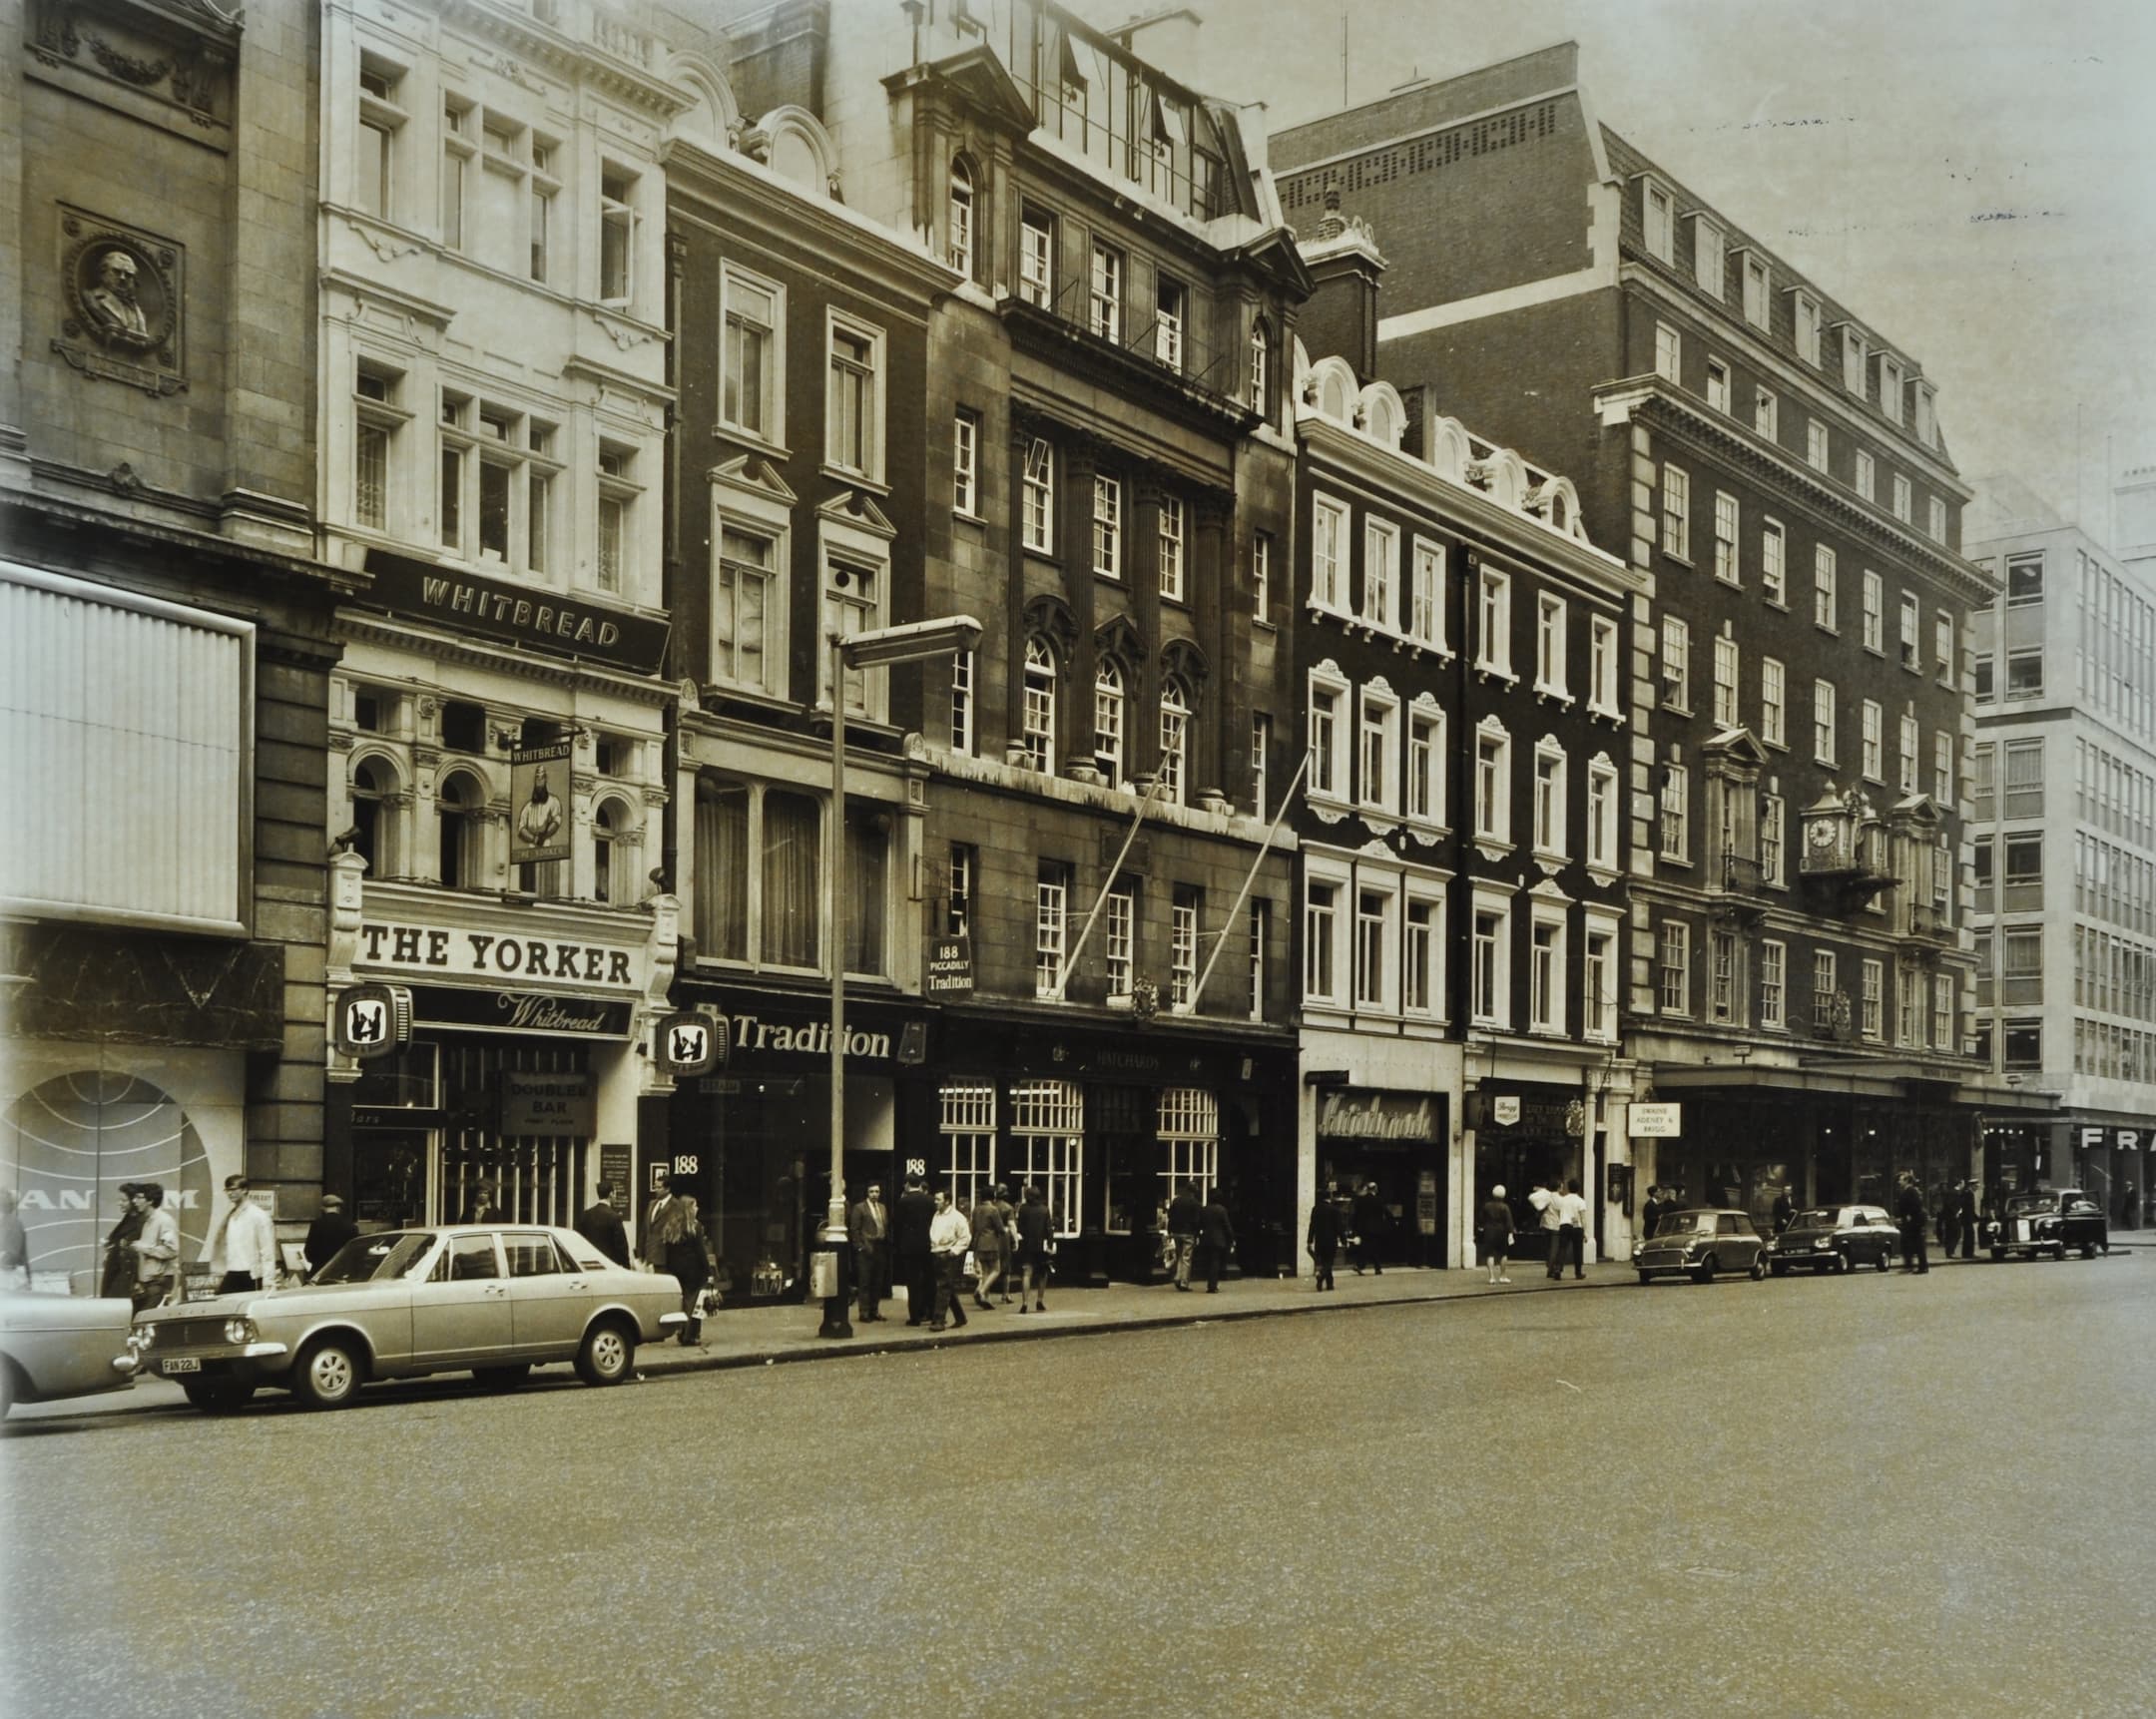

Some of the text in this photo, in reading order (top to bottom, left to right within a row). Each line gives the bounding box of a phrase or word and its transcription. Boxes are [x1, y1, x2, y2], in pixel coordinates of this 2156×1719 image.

[423, 576, 620, 648] WHITBREAD
[513, 745, 570, 762] WHITBREAD
[361, 924, 631, 984] THE YORKER
[940, 945, 959, 959] 188
[930, 960, 969, 971] PICCADILLY
[928, 974, 972, 990] Tradition
[497, 993, 606, 1031] Whitbread
[734, 1015, 890, 1058] Tradiion
[533, 1100, 568, 1114] BAR
[674, 1154, 699, 1175] 188
[906, 1158, 926, 1176] 188
[10, 1189, 97, 1210] AN
